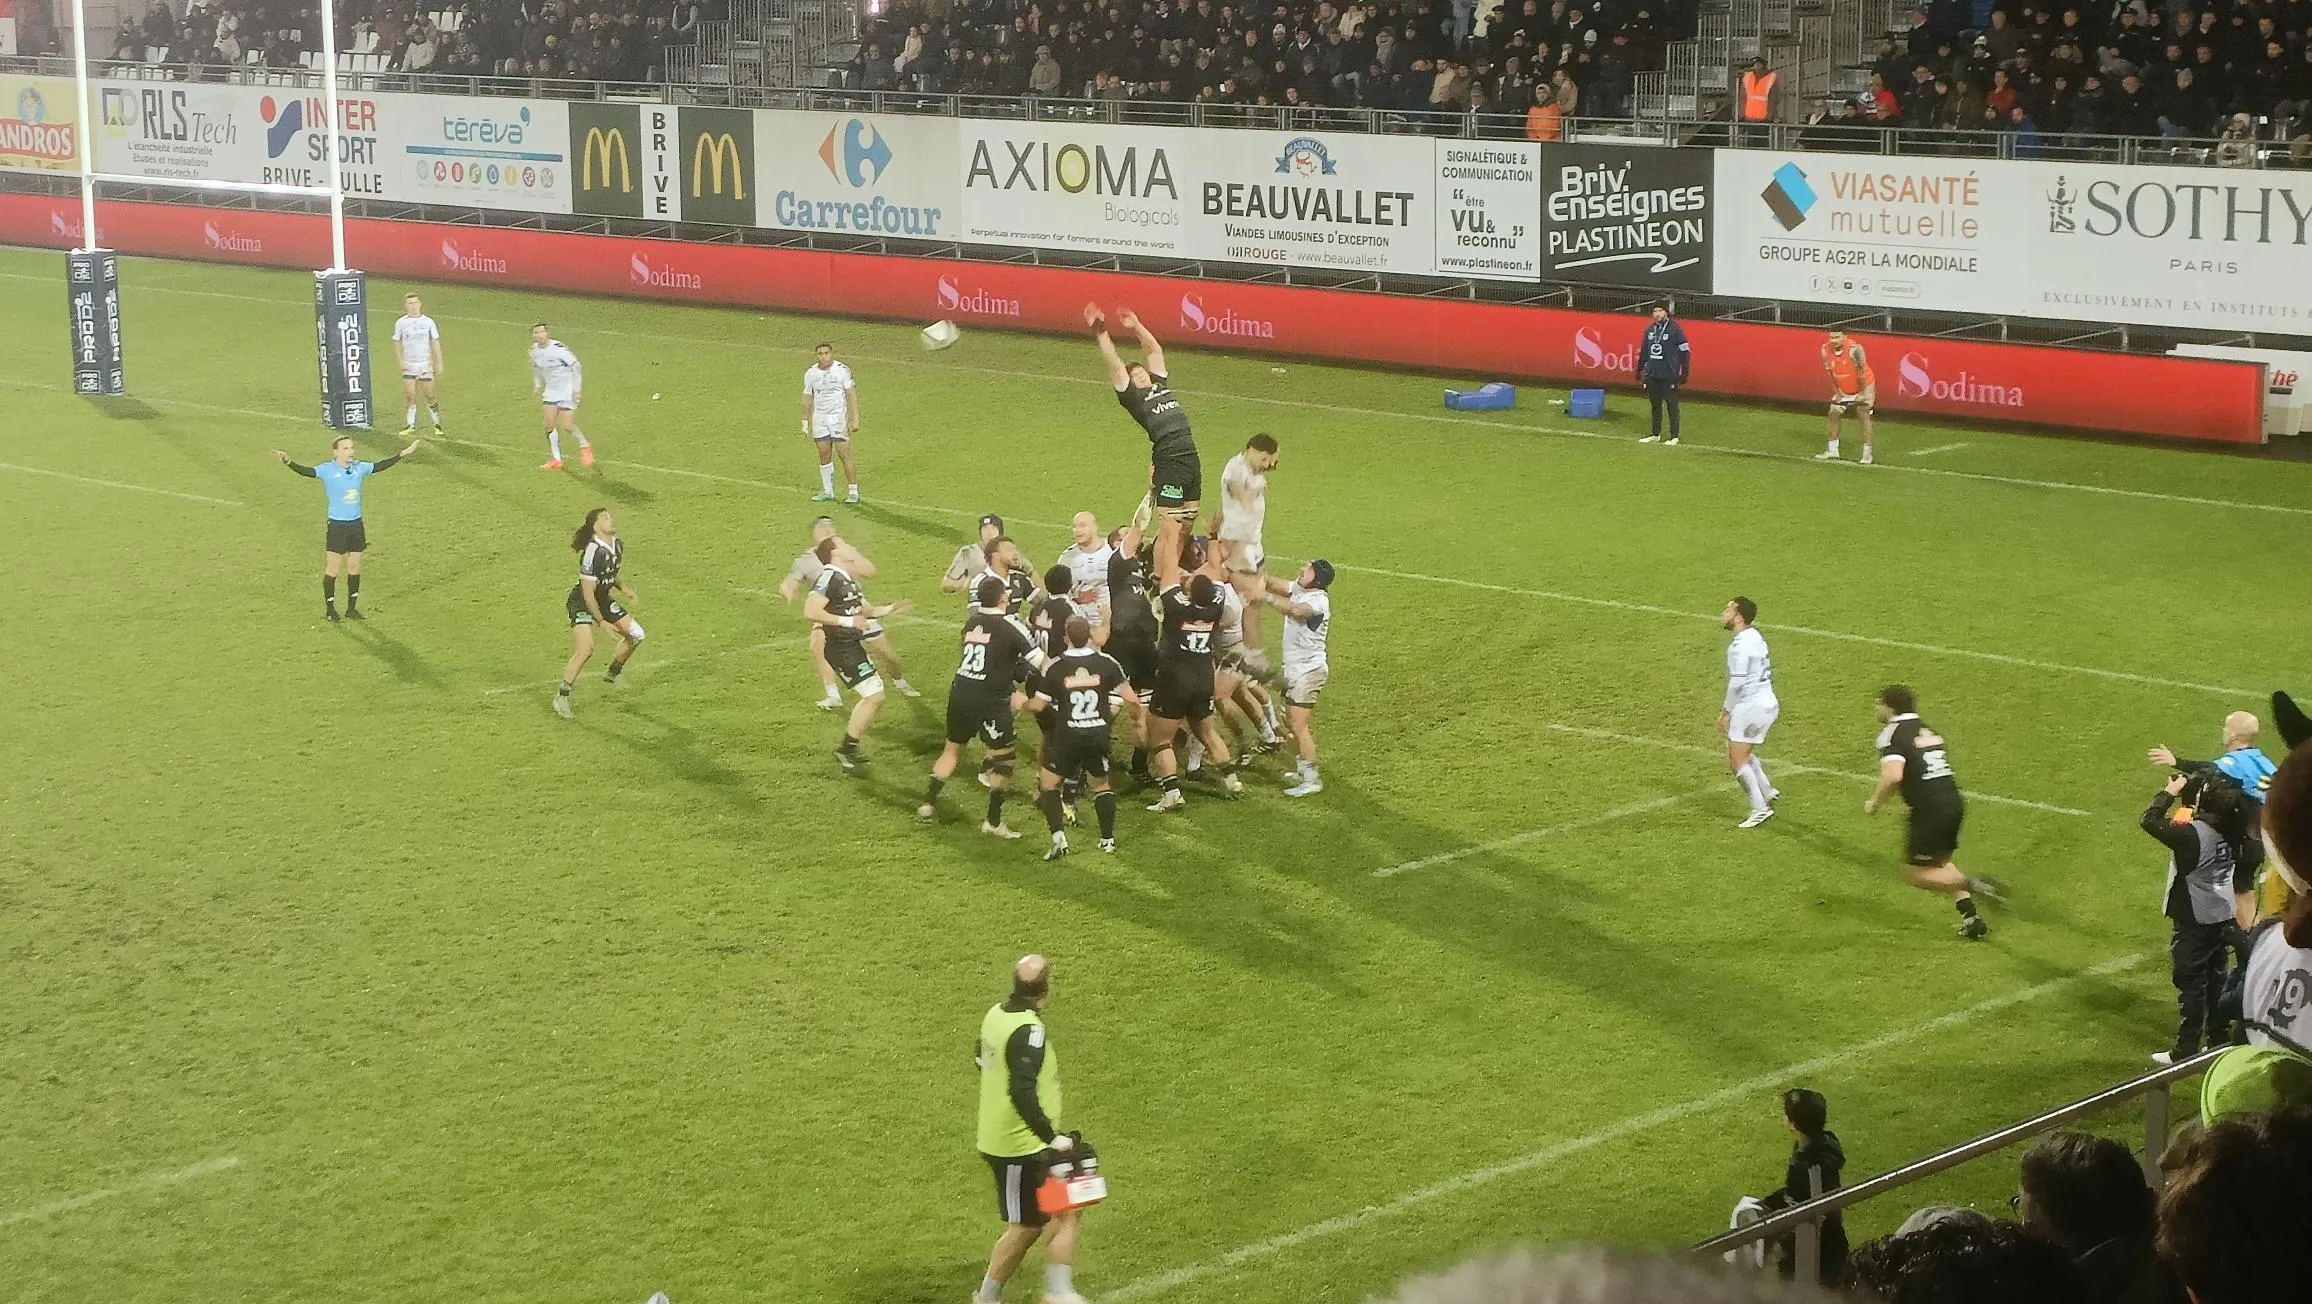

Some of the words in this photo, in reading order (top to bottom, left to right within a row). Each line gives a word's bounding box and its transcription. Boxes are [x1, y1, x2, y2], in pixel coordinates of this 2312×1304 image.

[142, 89, 188, 141] RLS
[192, 112, 237, 144] Tech
[652, 112, 669, 213] BRIVE
[966, 139, 1178, 199] AXIOMA
[1447, 149, 1517, 165] SIGNALÉTIQUE
[263, 166, 312, 187] BRIVE
[341, 171, 382, 193] ULLE
[1442, 168, 1533, 182] COMMUNICATION
[1831, 170, 1979, 206] VIASANTÉ
[775, 190, 942, 235] Carrefour
[1105, 202, 1179, 226] Biologicals
[1203, 182, 1414, 226] BEAUVALLET
[1549, 185, 1705, 222] Enseignes
[52, 208, 104, 240] Sodia
[204, 221, 262, 251] Sodima
[1268, 230, 1324, 243] LIMOUSINES
[1451, 209, 1484, 234] vu
[1549, 218, 1704, 255] PLASTINEON
[1831, 208, 1979, 239] mutuelle
[442, 237, 507, 273] Sodima
[631, 251, 701, 289] Sodima
[1297, 251, 1388, 267] www.beauvallet.fr
[1442, 256, 1533, 271] www.plastineon.fr
[1759, 245, 1821, 263] GROUPE
[1825, 250, 1866, 265] AG2R
[1871, 252, 1891, 267] LA
[1896, 254, 1978, 272] MONDIALE
[2170, 259, 2238, 274] PARIS
[937, 273, 1020, 316] Sodima
[2043, 291, 2174, 310] EXCLUSIVEMENT
[2183, 300, 2201, 312] EN
[2211, 302, 2298, 319] INSTITUTS
[1180, 292, 1274, 339] Sodima
[1574, 326, 1641, 372] Sodi
[1898, 351, 2024, 406] Sodima
[1186, 631, 1210, 649] 17
[962, 643, 986, 672] 23
[1069, 689, 1099, 720] 22
